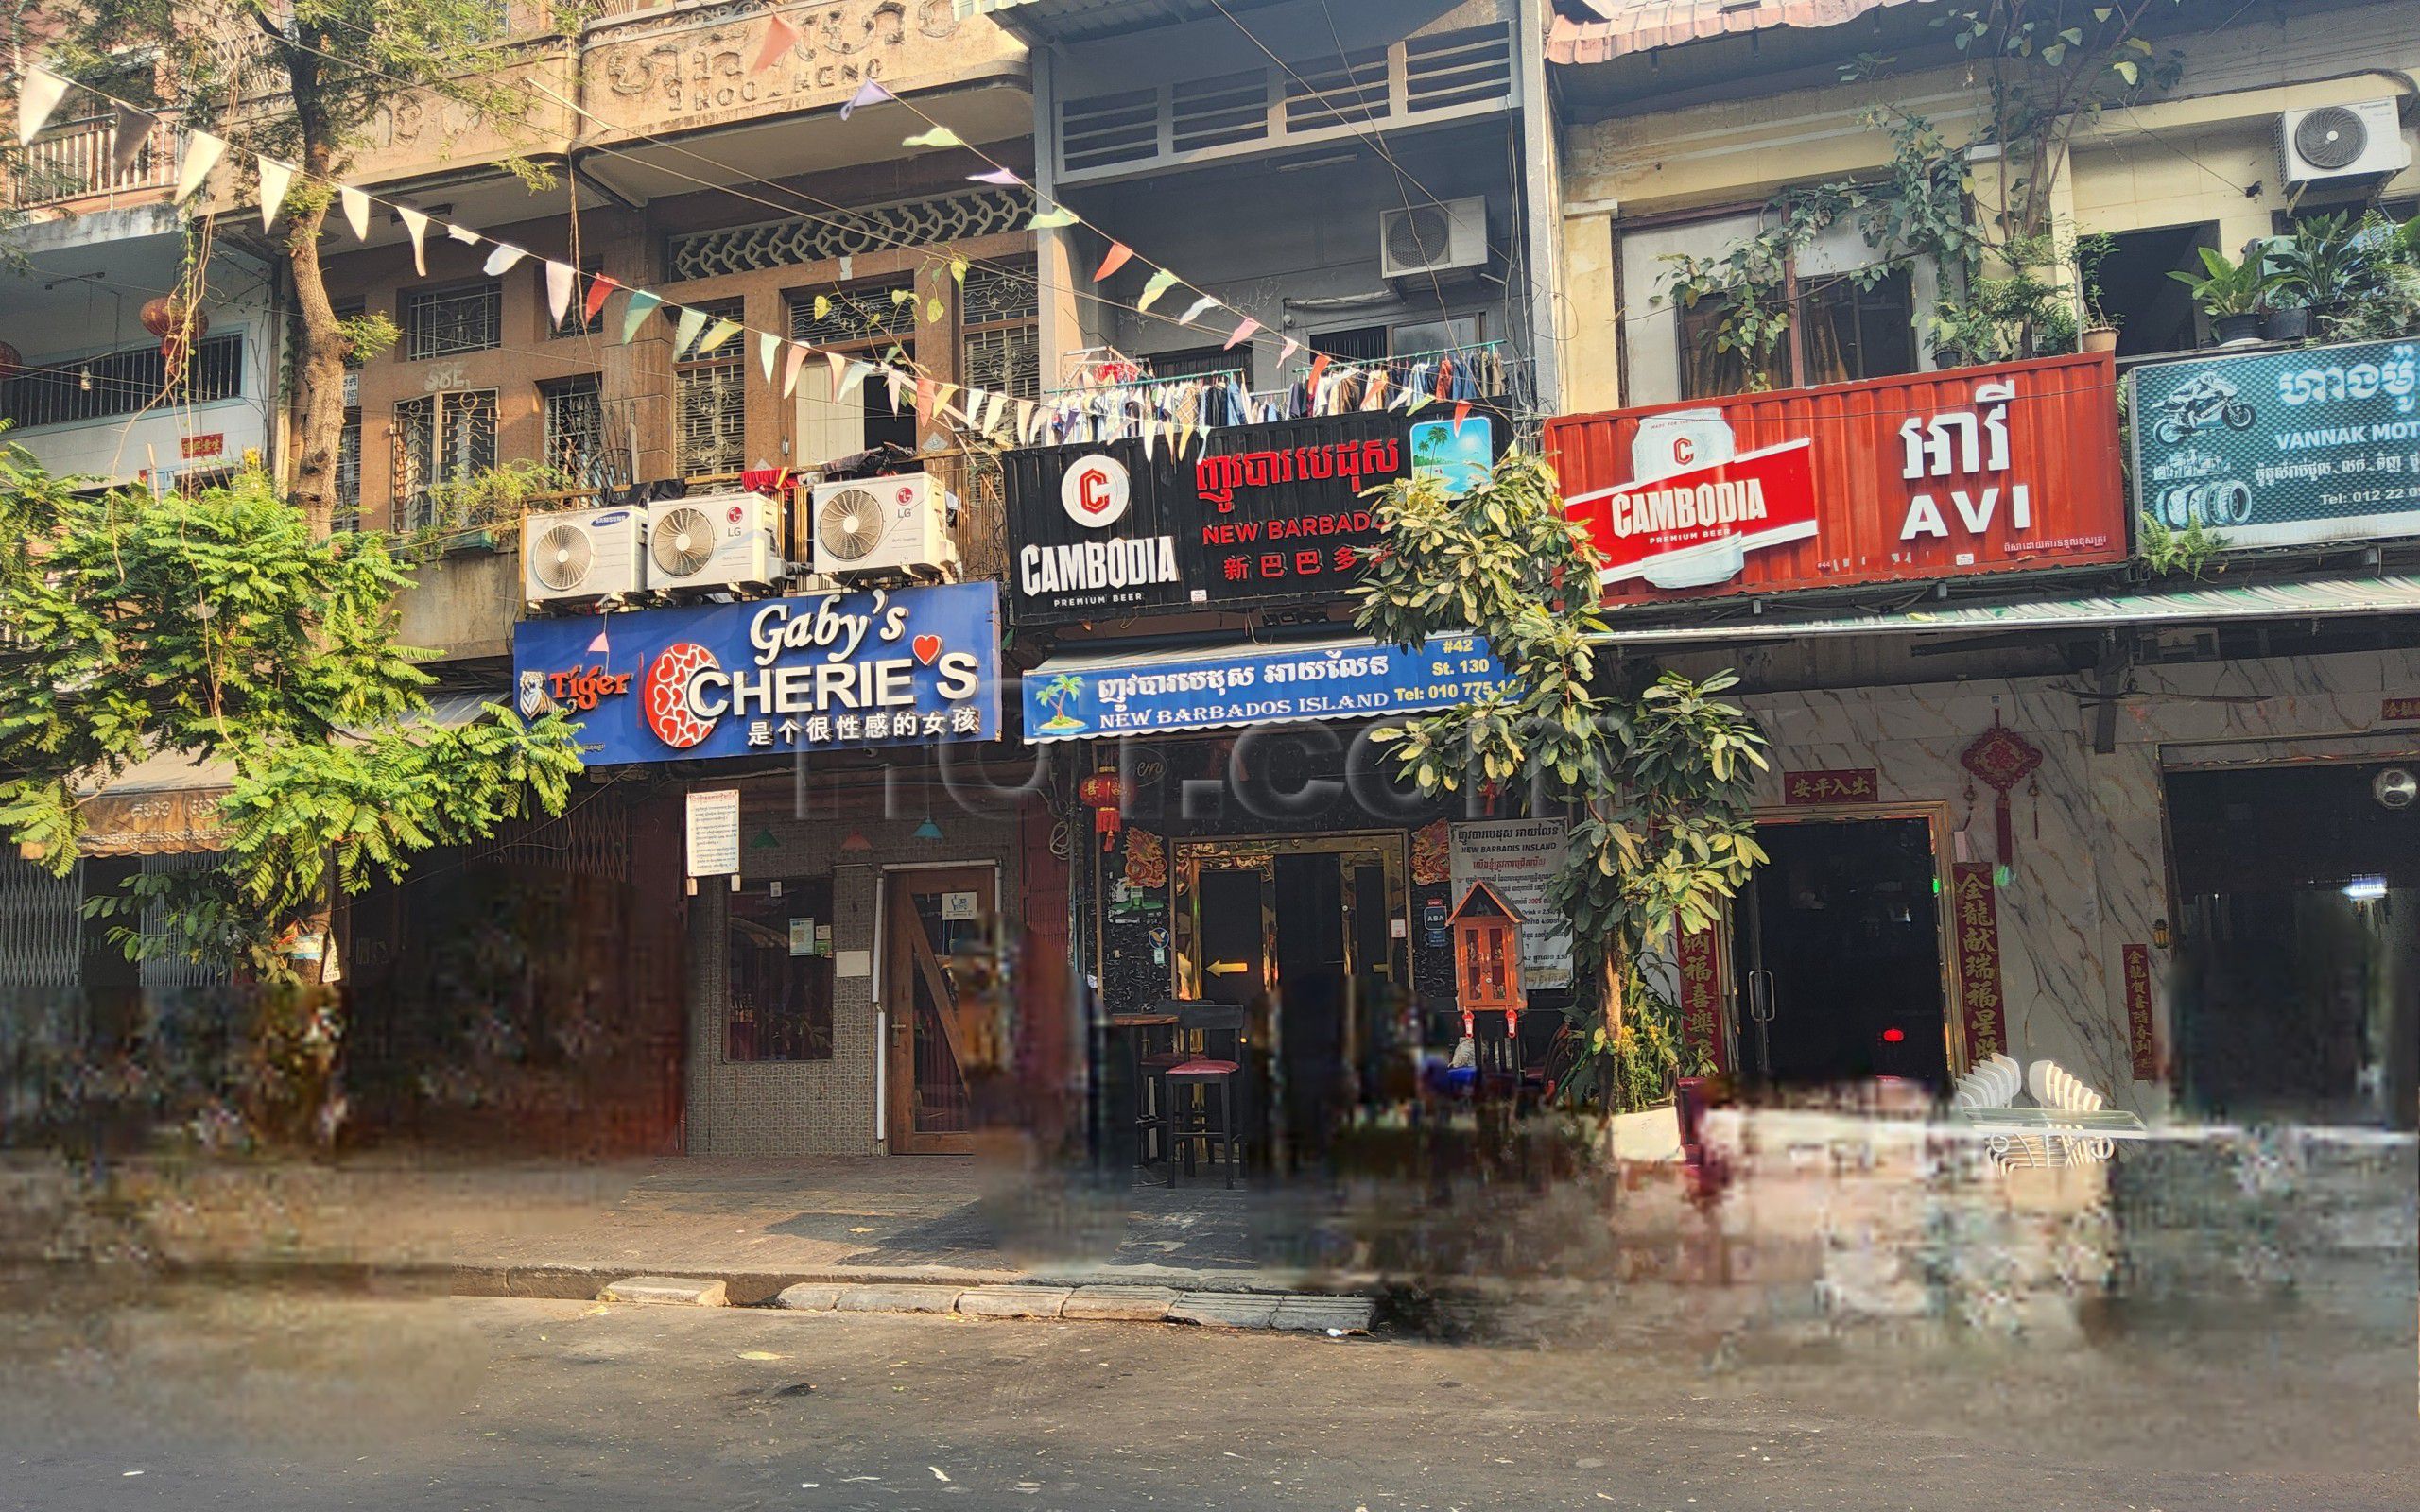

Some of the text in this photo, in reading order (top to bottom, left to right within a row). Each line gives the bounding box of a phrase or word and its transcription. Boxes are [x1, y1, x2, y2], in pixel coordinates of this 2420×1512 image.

[2275, 425, 2367, 451] VANNAK
[2320, 493, 2348, 506] Tel:
[2353, 490, 2381, 502] 012
[2385, 488, 2405, 500] 22
[898, 508, 911, 518] LG
[1611, 478, 1767, 539] CAMBODIA
[1899, 485, 2031, 540] AVI
[594, 515, 627, 524] SAMSUNG
[1202, 511, 1390, 545] NEW BARBADO
[727, 527, 741, 537] LG
[1650, 527, 1731, 544] PREMIUM BEER
[1020, 536, 1178, 597] CAMBODIA
[1053, 593, 1143, 607] PREMIUM BEER
[751, 590, 908, 665] Gaby's
[1443, 639, 1474, 653] #42
[1431, 659, 1490, 677] St. 130
[551, 666, 631, 710] Tiger
[1394, 687, 1424, 703] Tel:
[1427, 684, 1460, 699] 010
[1099, 692, 1389, 729] NEW BARBADOS ISLAND
[748, 707, 979, 747] 是个很性感的女孩
[1523, 843, 1557, 851] INSLAND
